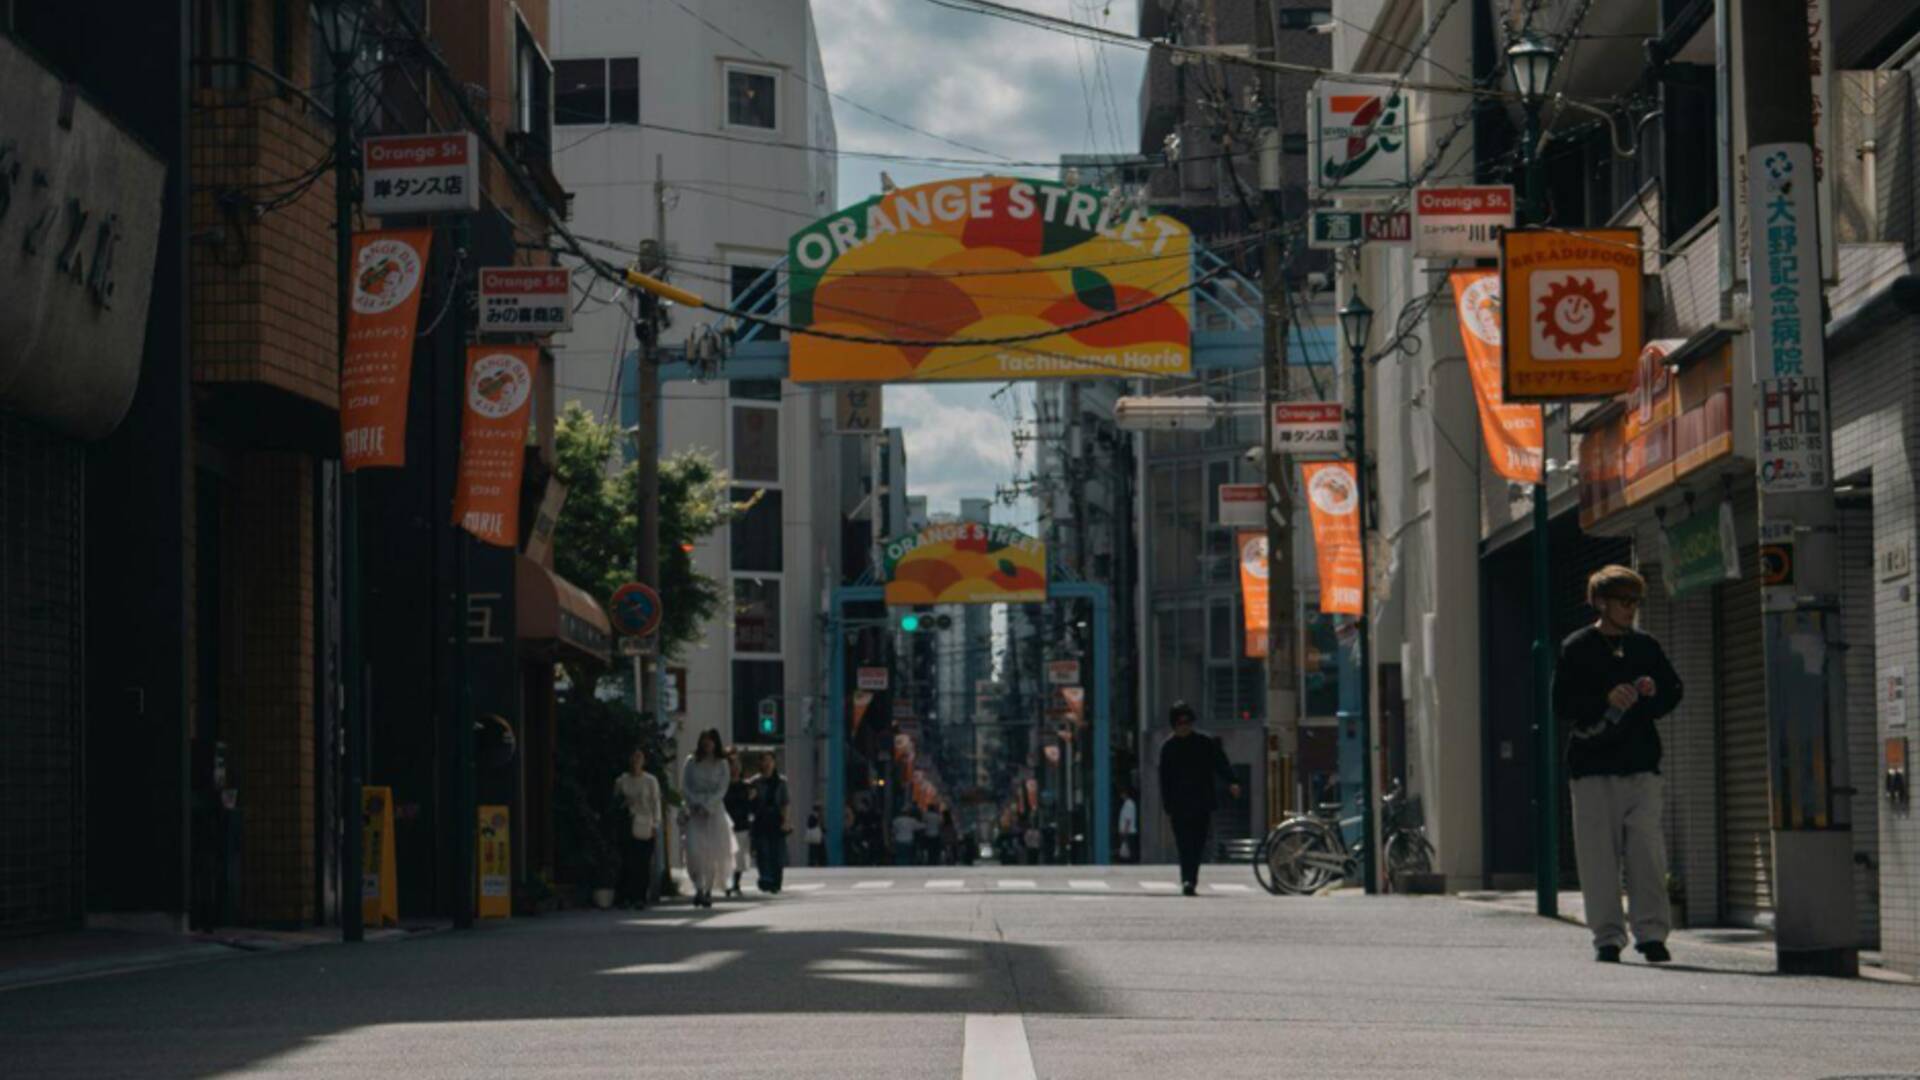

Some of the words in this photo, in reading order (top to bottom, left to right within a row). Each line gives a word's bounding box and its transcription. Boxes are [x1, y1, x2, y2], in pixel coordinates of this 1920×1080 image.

[371, 146, 436, 164] Orange
[442, 143, 463, 157] St.
[373, 176, 464, 198] 岸タンス店
[1421, 194, 1482, 211] Orange
[1487, 193, 1507, 208] St.
[796, 183, 993, 269] ORANGE
[1008, 182, 1182, 257] STREET
[1326, 214, 1351, 239] 酒
[1369, 213, 1408, 239] ATM
[485, 273, 544, 291] Orange
[546, 273, 566, 288] St.
[1766, 195, 1803, 377] 大野記念病院
[997, 353, 1117, 370] Tachibana
[1123, 352, 1184, 369] Horie
[1279, 408, 1320, 420] Orange
[887, 525, 968, 560] ORANGE
[971, 524, 1041, 557] STREET
